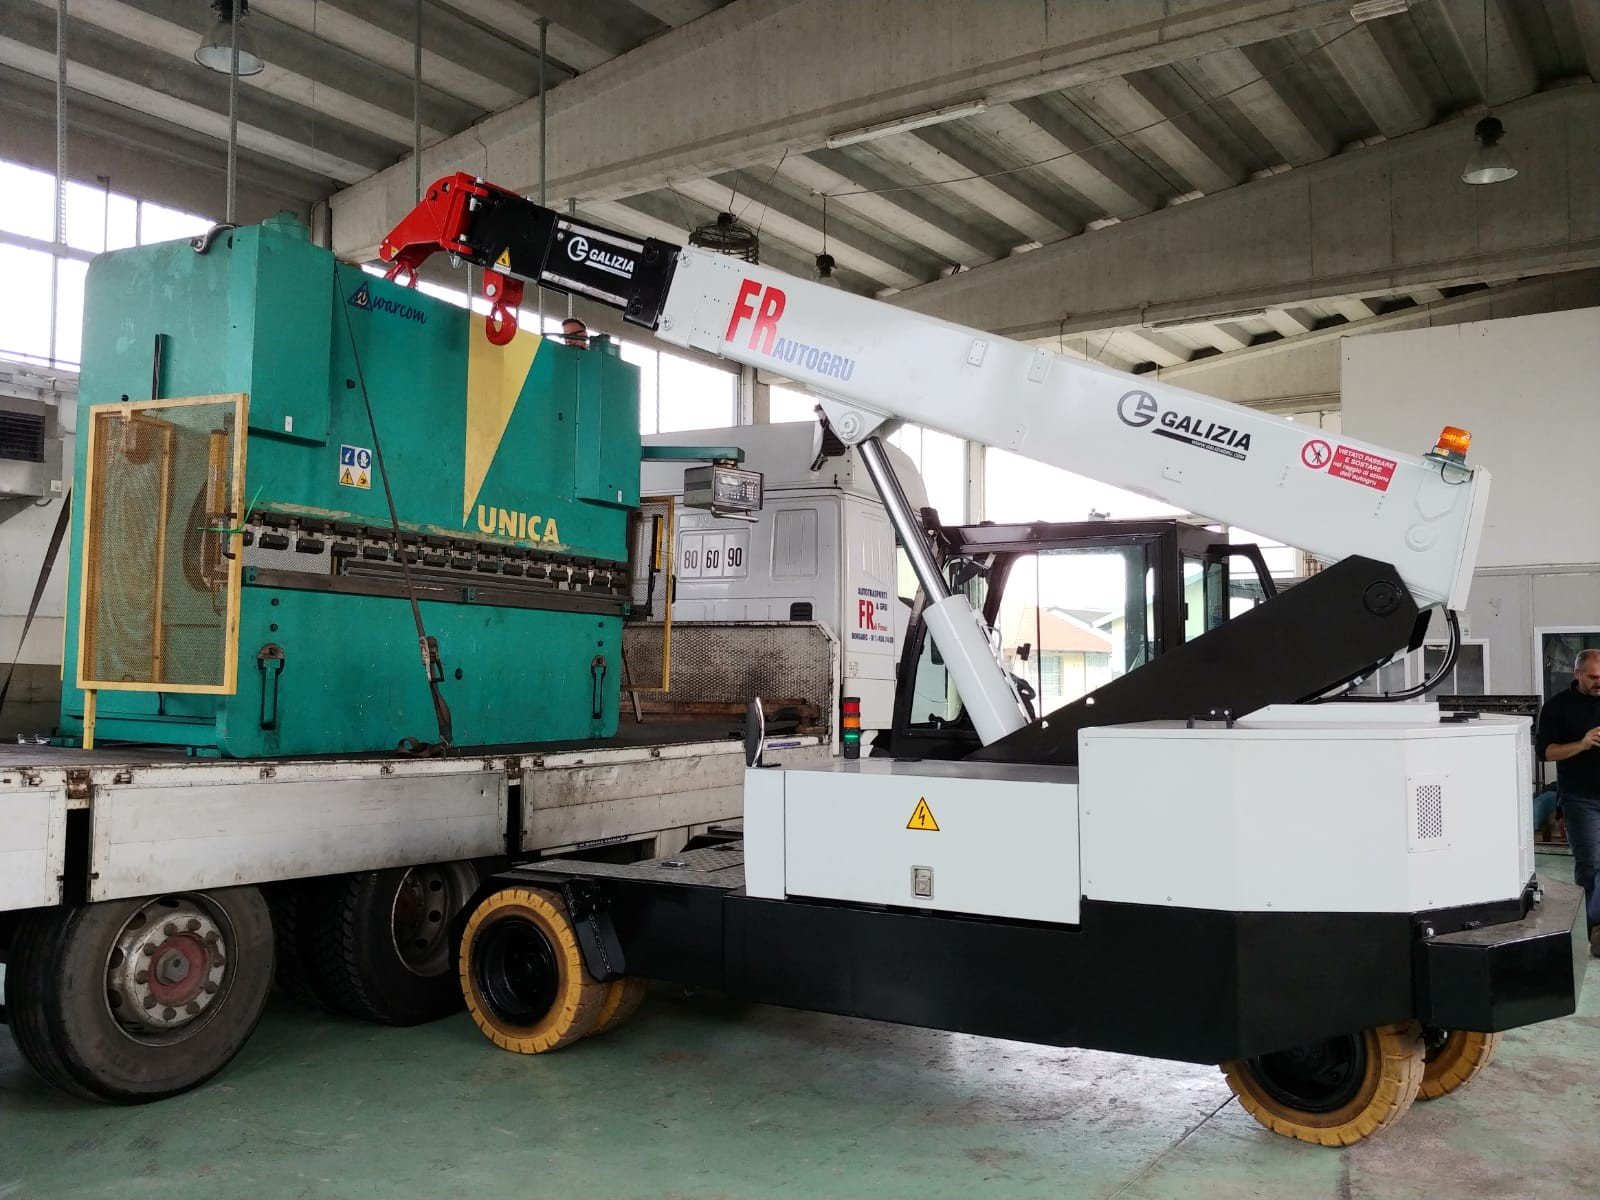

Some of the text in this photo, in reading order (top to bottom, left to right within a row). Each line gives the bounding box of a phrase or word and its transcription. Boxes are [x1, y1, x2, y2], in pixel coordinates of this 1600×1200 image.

[588, 248, 635, 273] GALIZIA
[373, 296, 427, 324] warcom
[725, 278, 787, 356] FR
[772, 337, 856, 381] AUTOGRU
[1160, 410, 1251, 451] GALIZIA
[1338, 448, 1394, 469] VIETATO PASSARE
[1350, 458, 1382, 473] SOSTARE
[477, 504, 560, 545] UNICA
[683, 547, 742, 569] 80 60 90
[858, 599, 874, 630] FR
